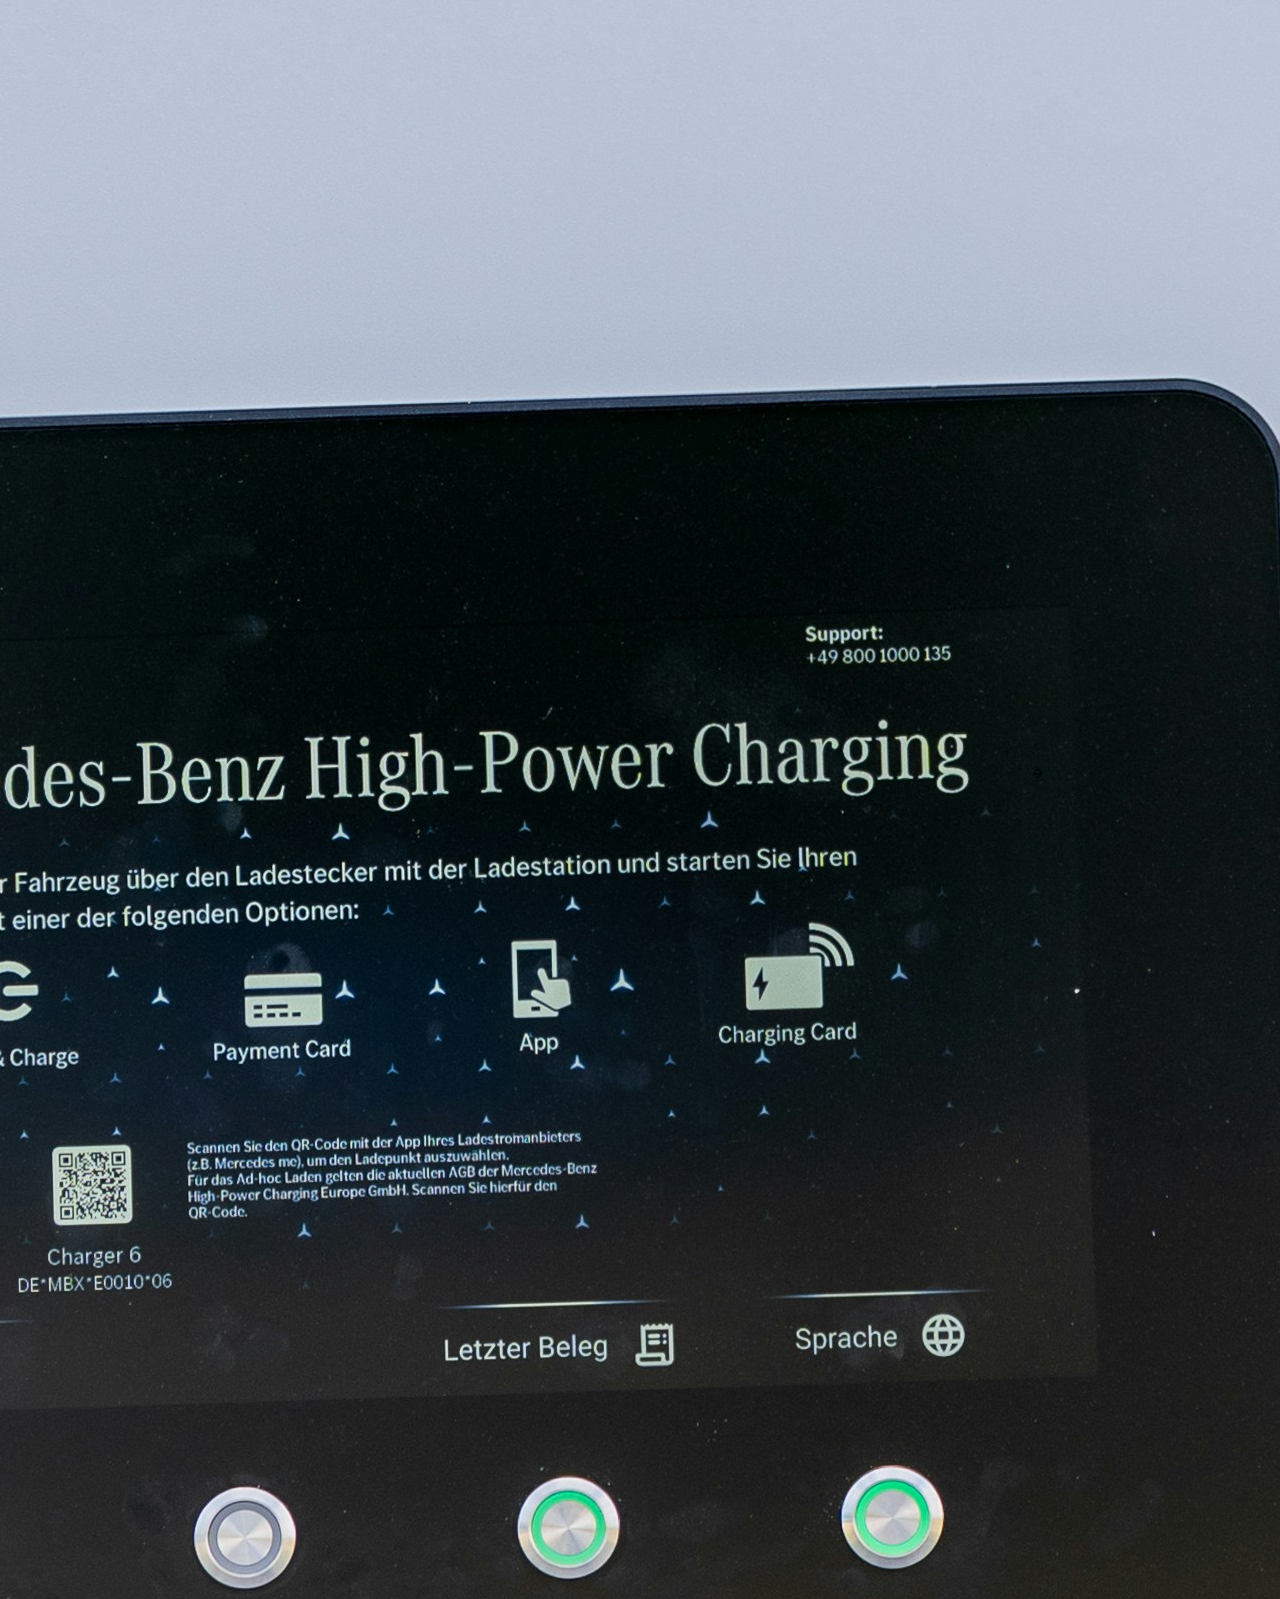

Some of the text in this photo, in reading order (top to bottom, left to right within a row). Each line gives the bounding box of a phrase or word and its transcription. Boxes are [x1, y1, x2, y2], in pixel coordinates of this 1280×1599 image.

[805, 625, 884, 645] Support:
[806, 645, 952, 665] +49 800 1000 135
[304, 730, 674, 812] High-Power
[693, 719, 969, 797] Charging
[14, 871, 121, 896] Fahrzeug
[126, 867, 180, 892] über
[185, 866, 229, 888] den
[235, 861, 378, 887] Ladestecker
[384, 859, 422, 882] mit
[428, 858, 468, 880] der
[474, 854, 611, 879] Ladestation
[617, 851, 660, 874] und
[667, 852, 750, 872] starten
[756, 848, 792, 869] Sie
[798, 846, 857, 872] Ihren
[12, 909, 71, 931] einer
[76, 906, 116, 929] der
[121, 902, 239, 931] folgenden
[245, 900, 359, 927] Optionen:
[519, 1032, 559, 1055] App
[718, 1021, 857, 1047] Charging Card
[9, 1047, 80, 1070] Charge
[213, 1038, 351, 1065] Payment Card
[186, 1130, 582, 1155] Scannen Sie den QR-Code mit der App Ihres Ladestromanbieters
[214, 1156, 276, 1170] Mercedes
[278, 1155, 305, 1169] me),
[306, 1156, 328, 1167] um
[328, 1153, 353, 1166] den
[354, 1151, 422, 1167] Ladepunkt
[423, 1148, 510, 1164] auszuwählen.
[187, 1162, 597, 1187] Für das Ad-hoc Laden gelten die aktuellen AGB der Mercedes-Benz
[187, 1179, 558, 1206] High-Power Charging Europe GmbH. Scannen Sie hierfür den
[188, 1205, 248, 1220] QR-Code.
[47, 1245, 142, 1269] Charger 6
[444, 1333, 608, 1363] Letzter Beleg
[795, 1324, 898, 1356] Sprache
